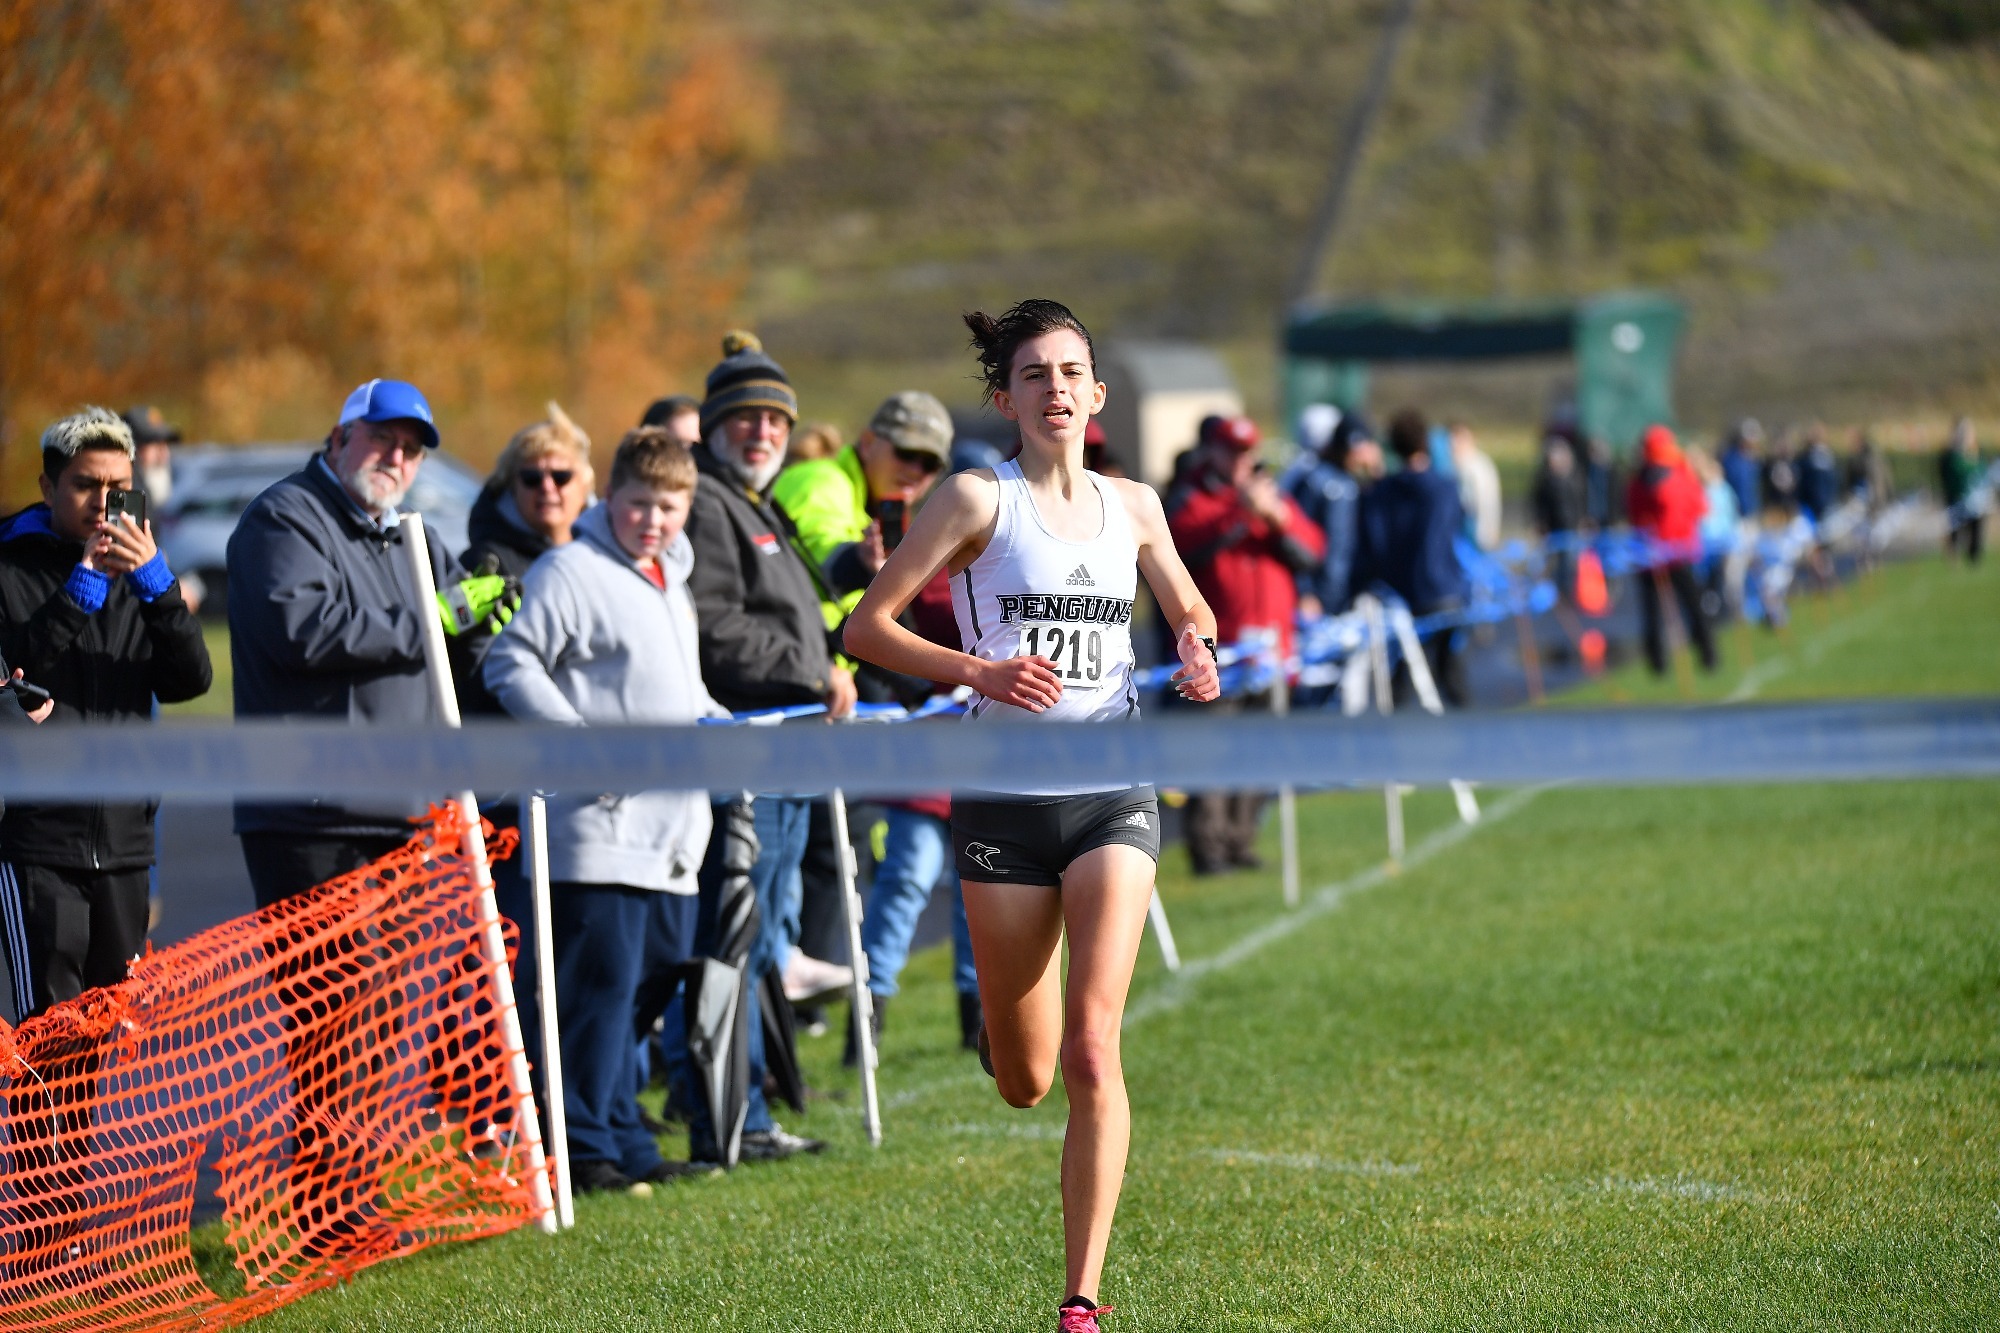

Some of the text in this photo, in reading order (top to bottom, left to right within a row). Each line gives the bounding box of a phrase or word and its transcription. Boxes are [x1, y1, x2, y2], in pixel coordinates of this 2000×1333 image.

[1066, 578, 1095, 586] adidas
[996, 594, 1134, 626] PENGUINS
[1027, 627, 1101, 681] 1219
